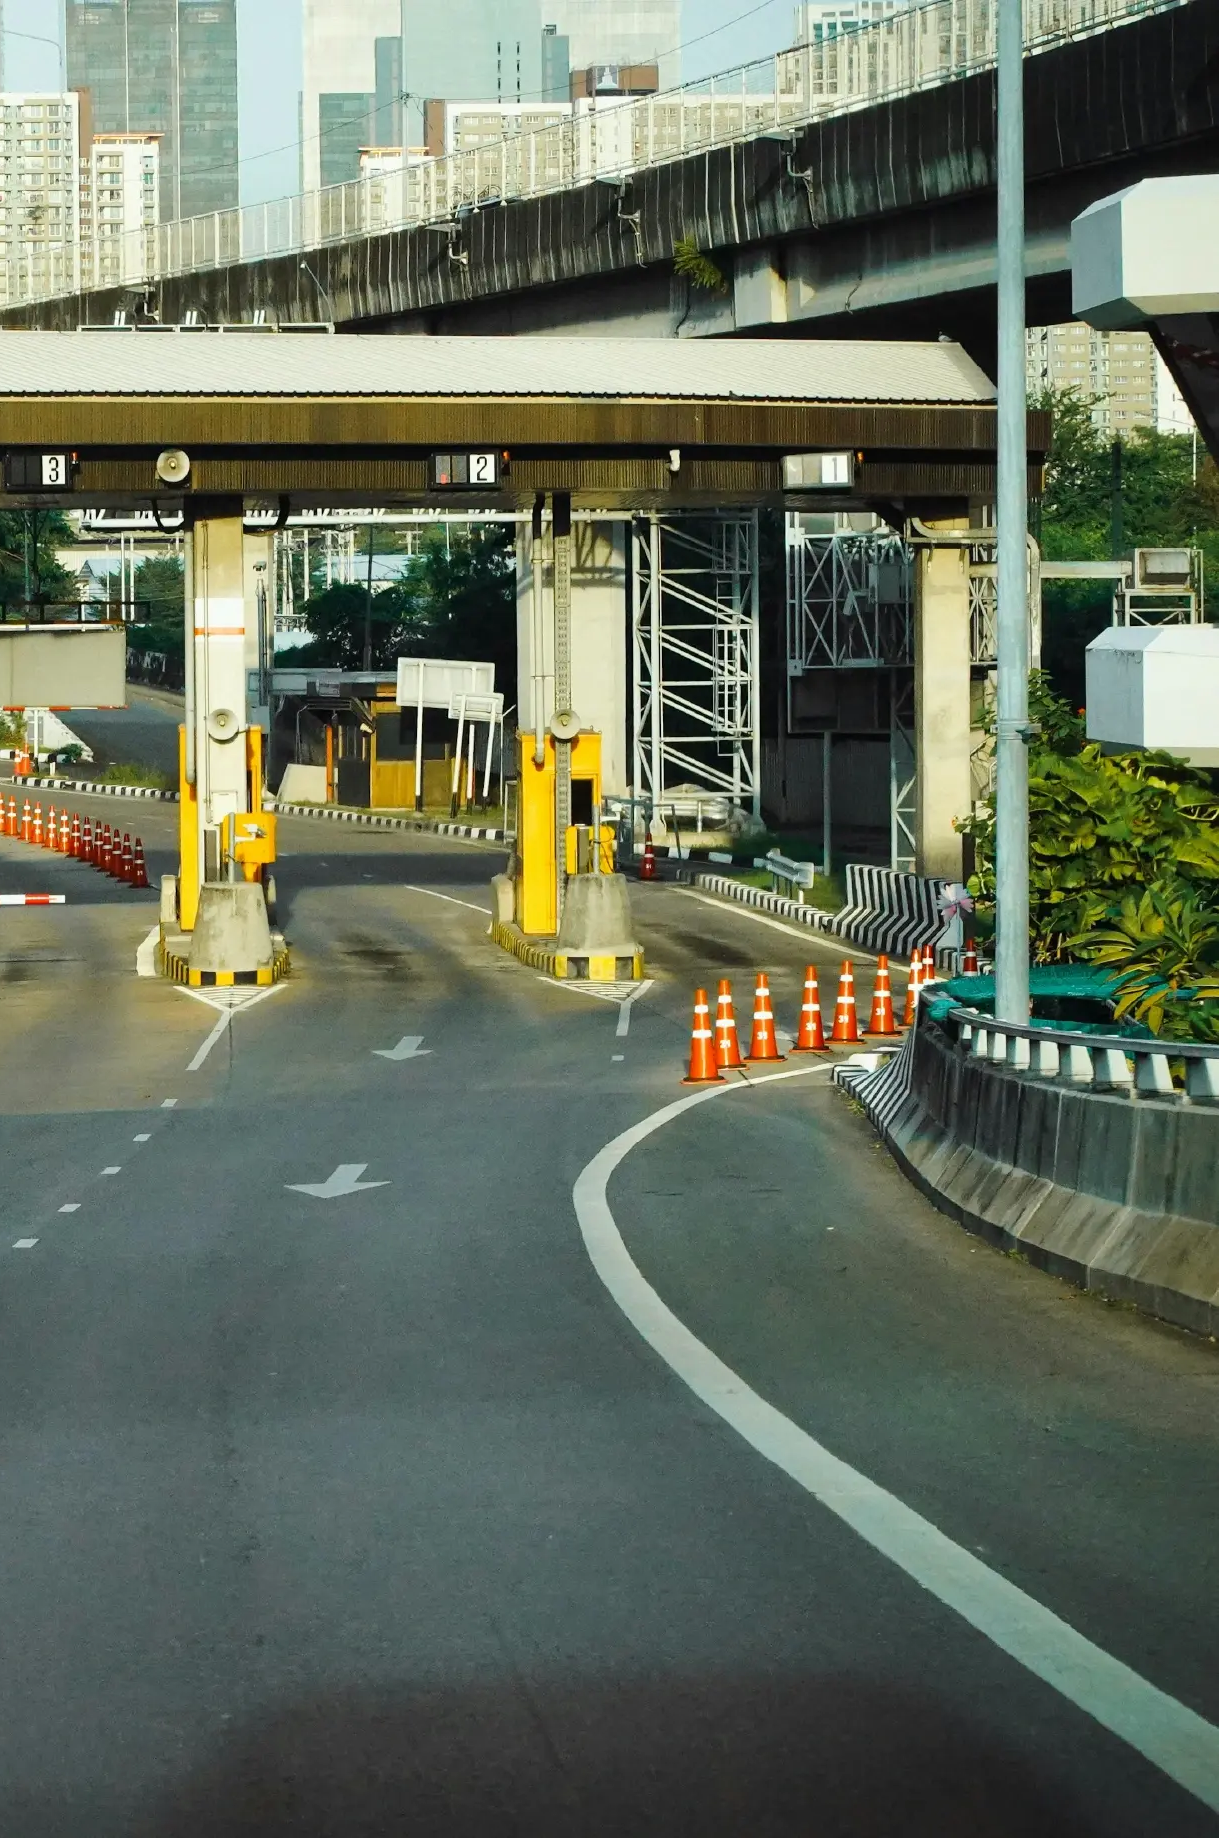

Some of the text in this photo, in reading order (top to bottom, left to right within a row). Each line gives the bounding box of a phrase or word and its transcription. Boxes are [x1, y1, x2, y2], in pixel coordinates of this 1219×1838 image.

[48, 457, 59, 482] 3
[476, 456, 488, 482] 2
[831, 456, 838, 481] 1
